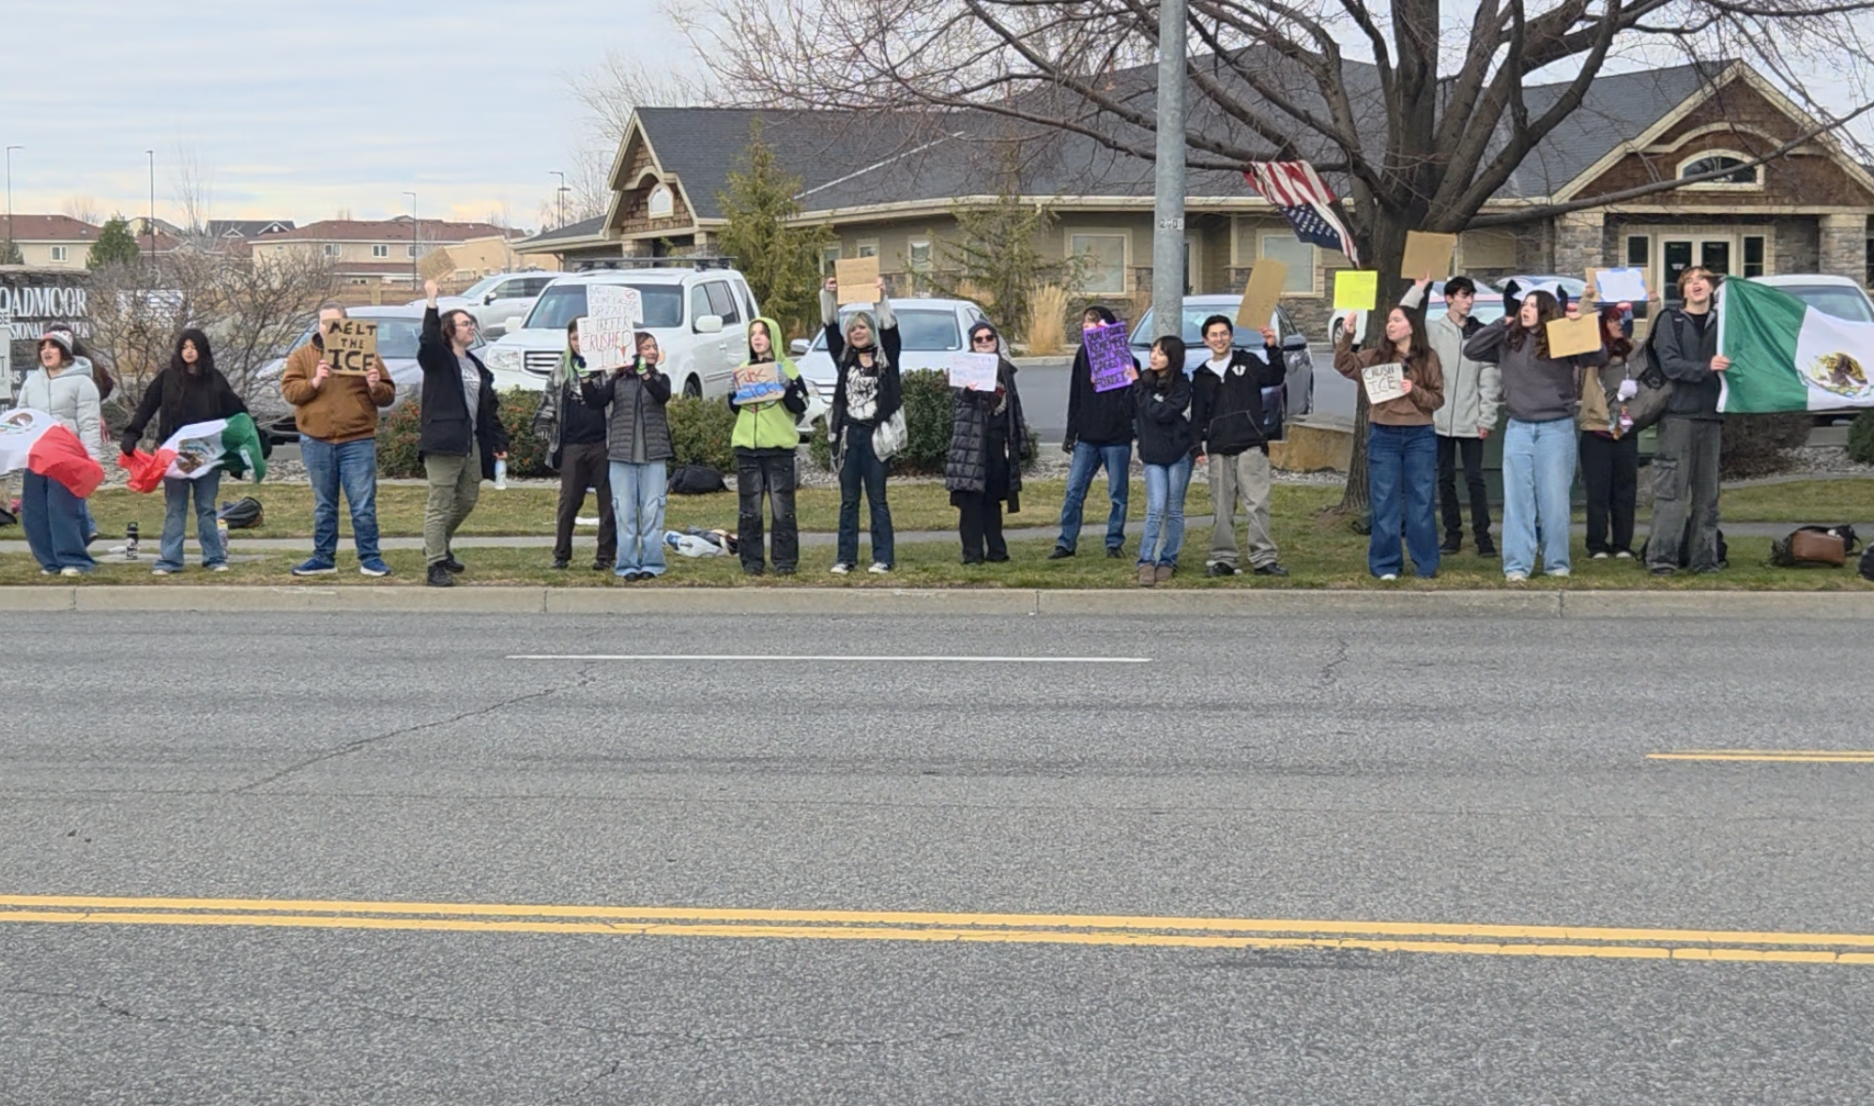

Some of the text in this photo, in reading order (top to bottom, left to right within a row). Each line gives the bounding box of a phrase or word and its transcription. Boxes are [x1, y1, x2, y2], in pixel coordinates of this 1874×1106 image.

[328, 321, 377, 336] MELT
[596, 315, 631, 332] PREFER
[341, 338, 364, 349] THE
[581, 329, 633, 352] CRUSHED
[328, 349, 375, 371] ICE
[1094, 370, 1127, 388] FORGE
[1364, 365, 1394, 380] CRUSH
[1368, 376, 1396, 394] ICE
